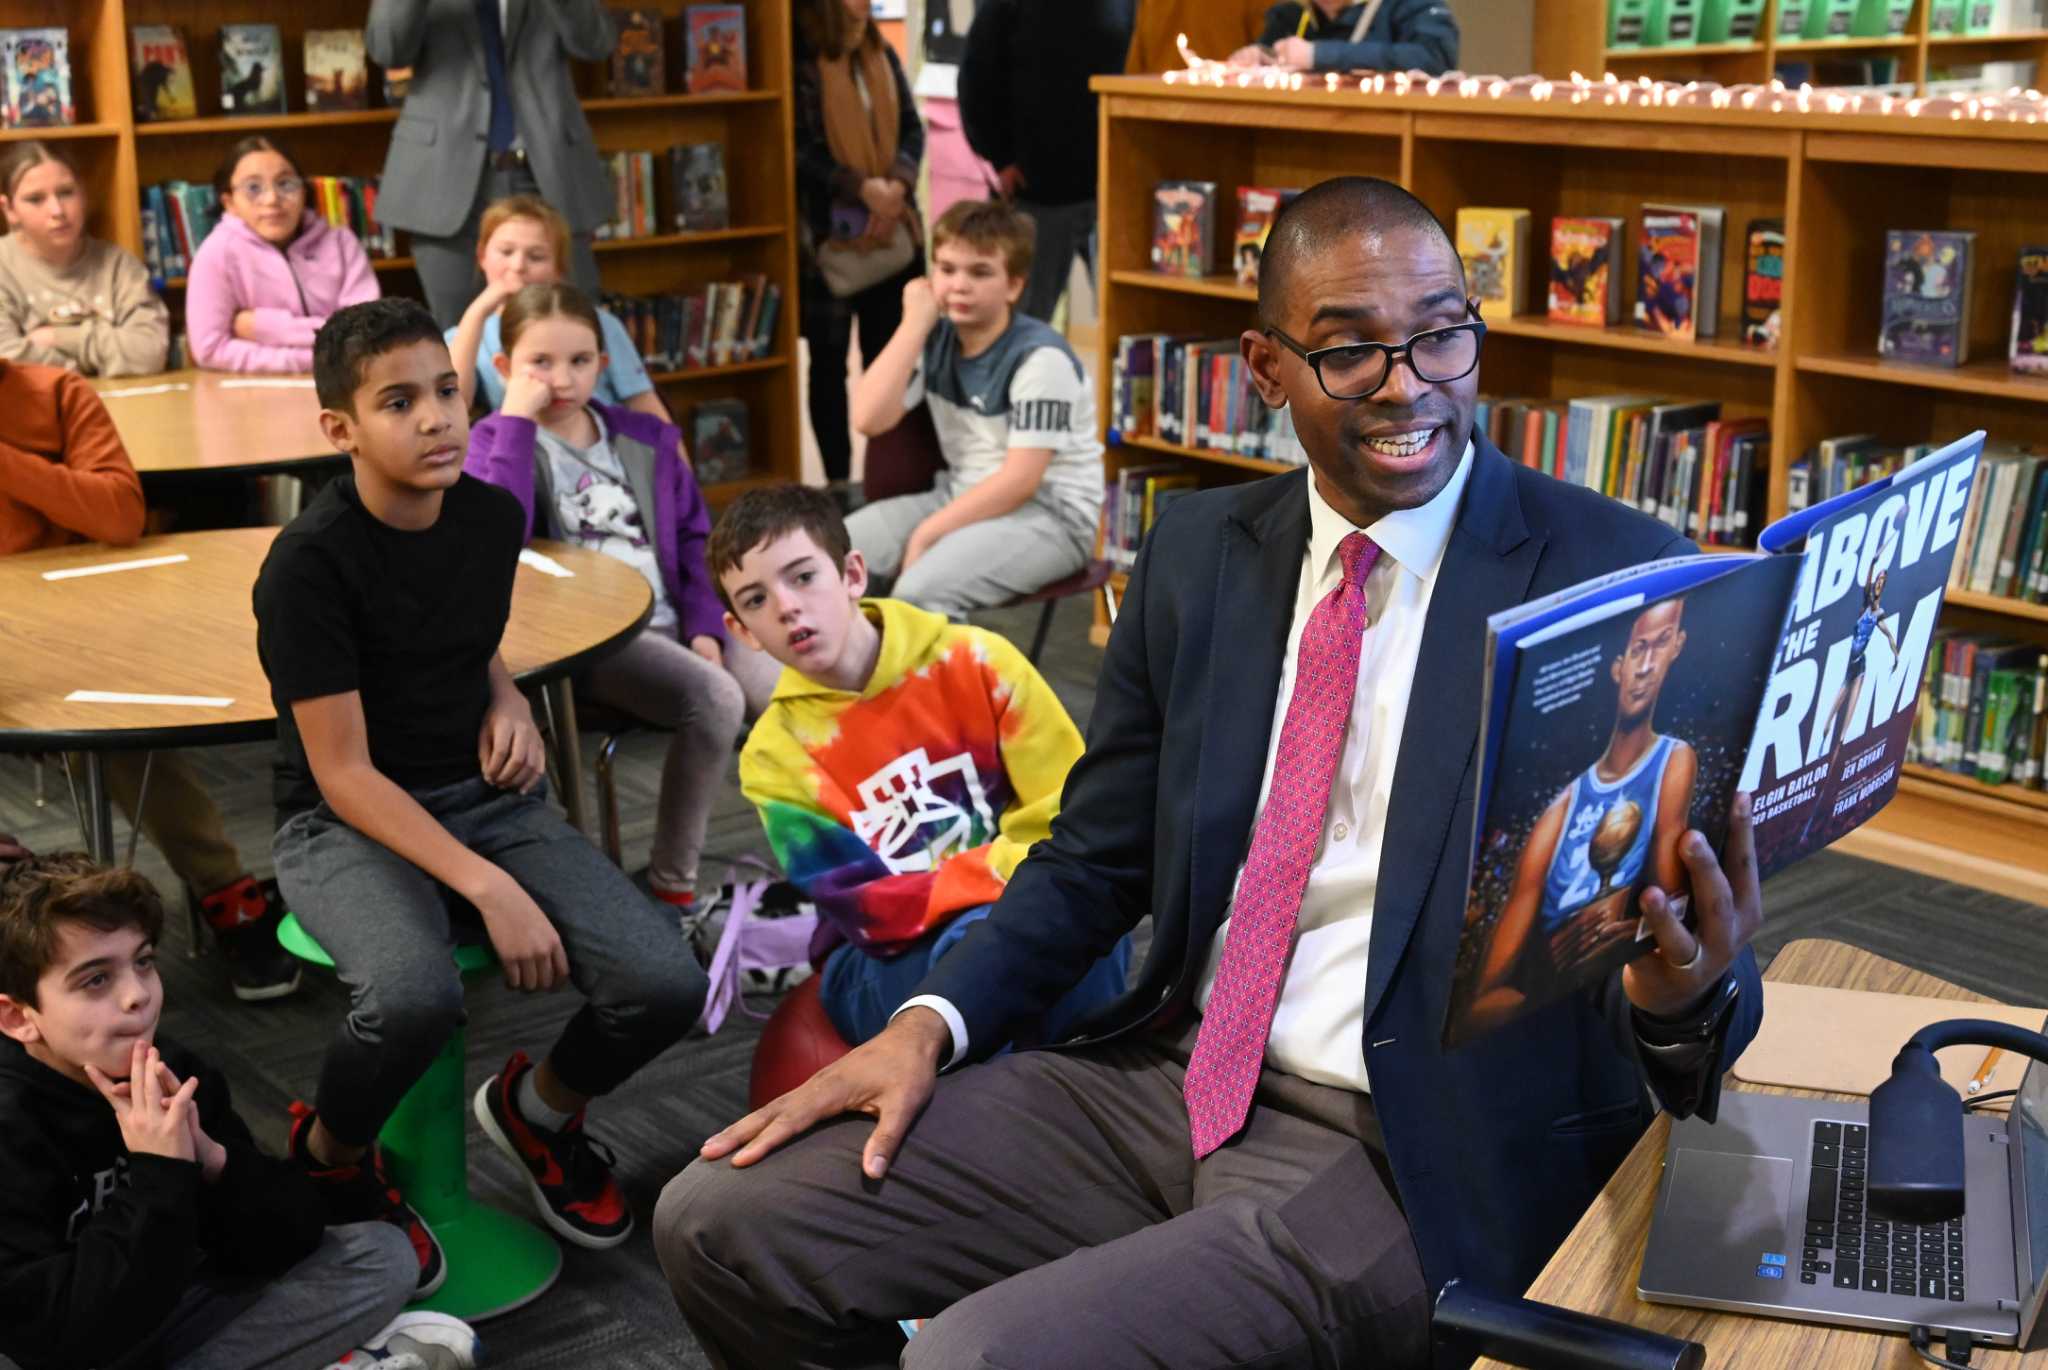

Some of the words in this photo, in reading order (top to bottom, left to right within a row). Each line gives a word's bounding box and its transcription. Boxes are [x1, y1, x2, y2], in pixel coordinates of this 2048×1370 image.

[1786, 454, 1976, 630] ABOVE
[1782, 619, 1822, 663] HE
[1737, 587, 1942, 792] RIM
[1840, 763, 1857, 782] JEN
[1857, 743, 1886, 772] BRYANT
[1753, 785, 1787, 813] ELGIN
[1787, 763, 1829, 797] BAYLOR
[1767, 787, 1816, 820] BASKETBALL
[1833, 791, 1858, 817] FRANK
[1858, 766, 1895, 803] MORRISON
